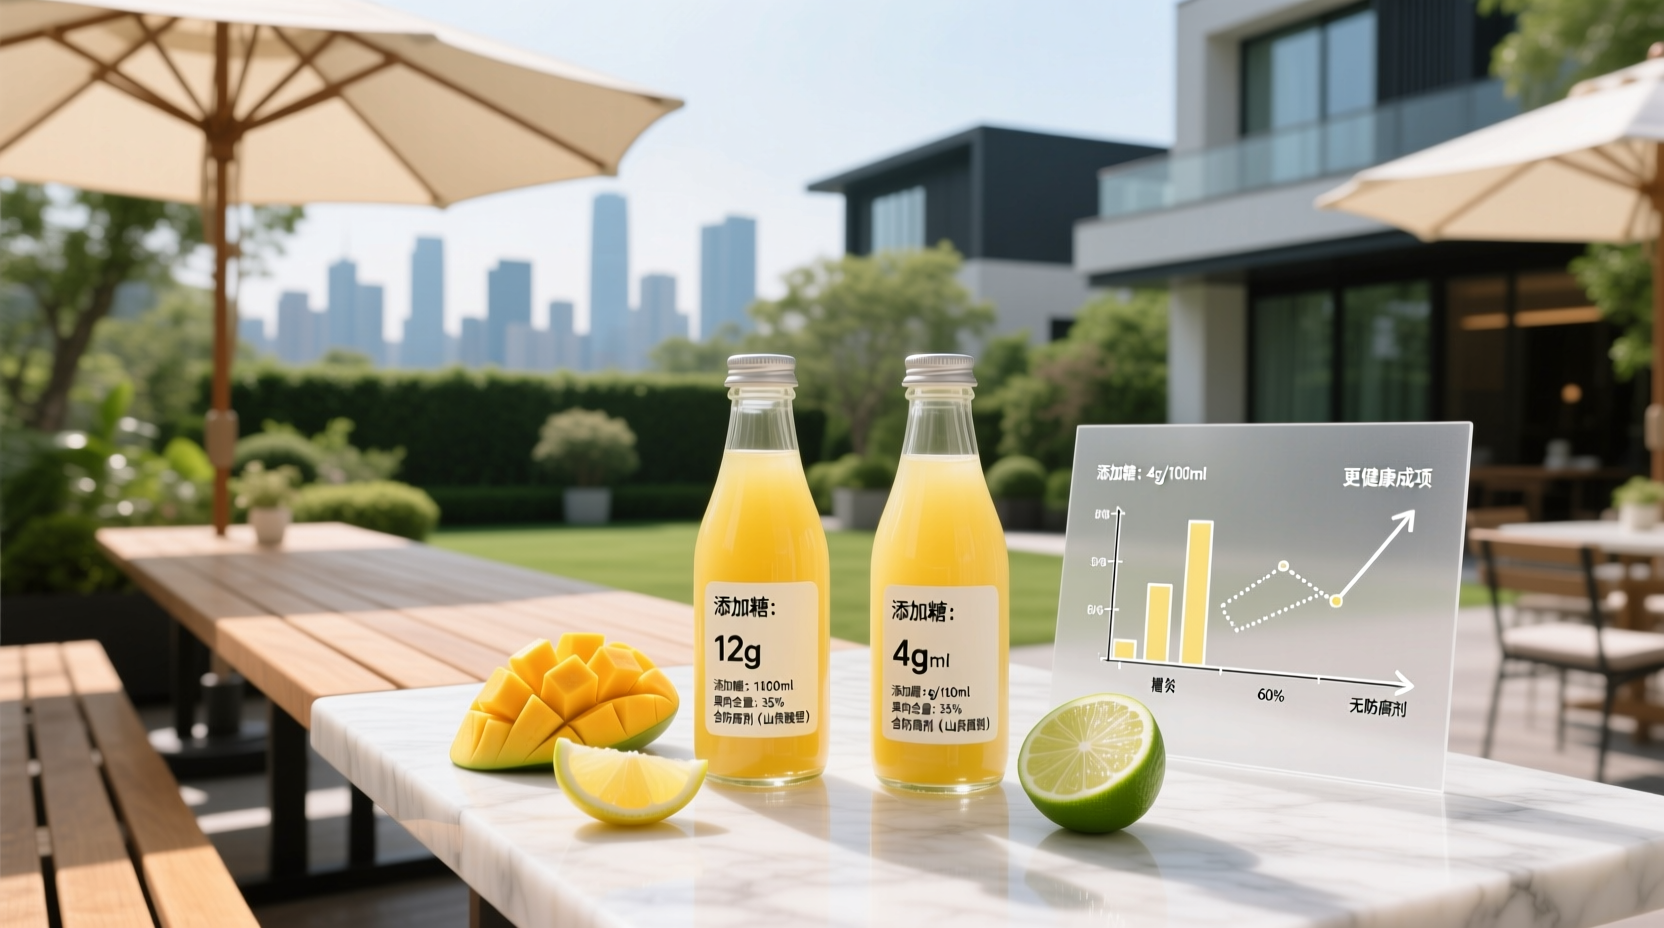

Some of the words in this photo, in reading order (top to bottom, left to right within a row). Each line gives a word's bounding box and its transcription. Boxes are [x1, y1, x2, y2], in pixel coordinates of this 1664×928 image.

[714, 596, 776, 618] 添加糖:
[891, 599, 954, 622] 添加糖:
[714, 635, 761, 670] 12g
[1257, 688, 1285, 702] 60%
